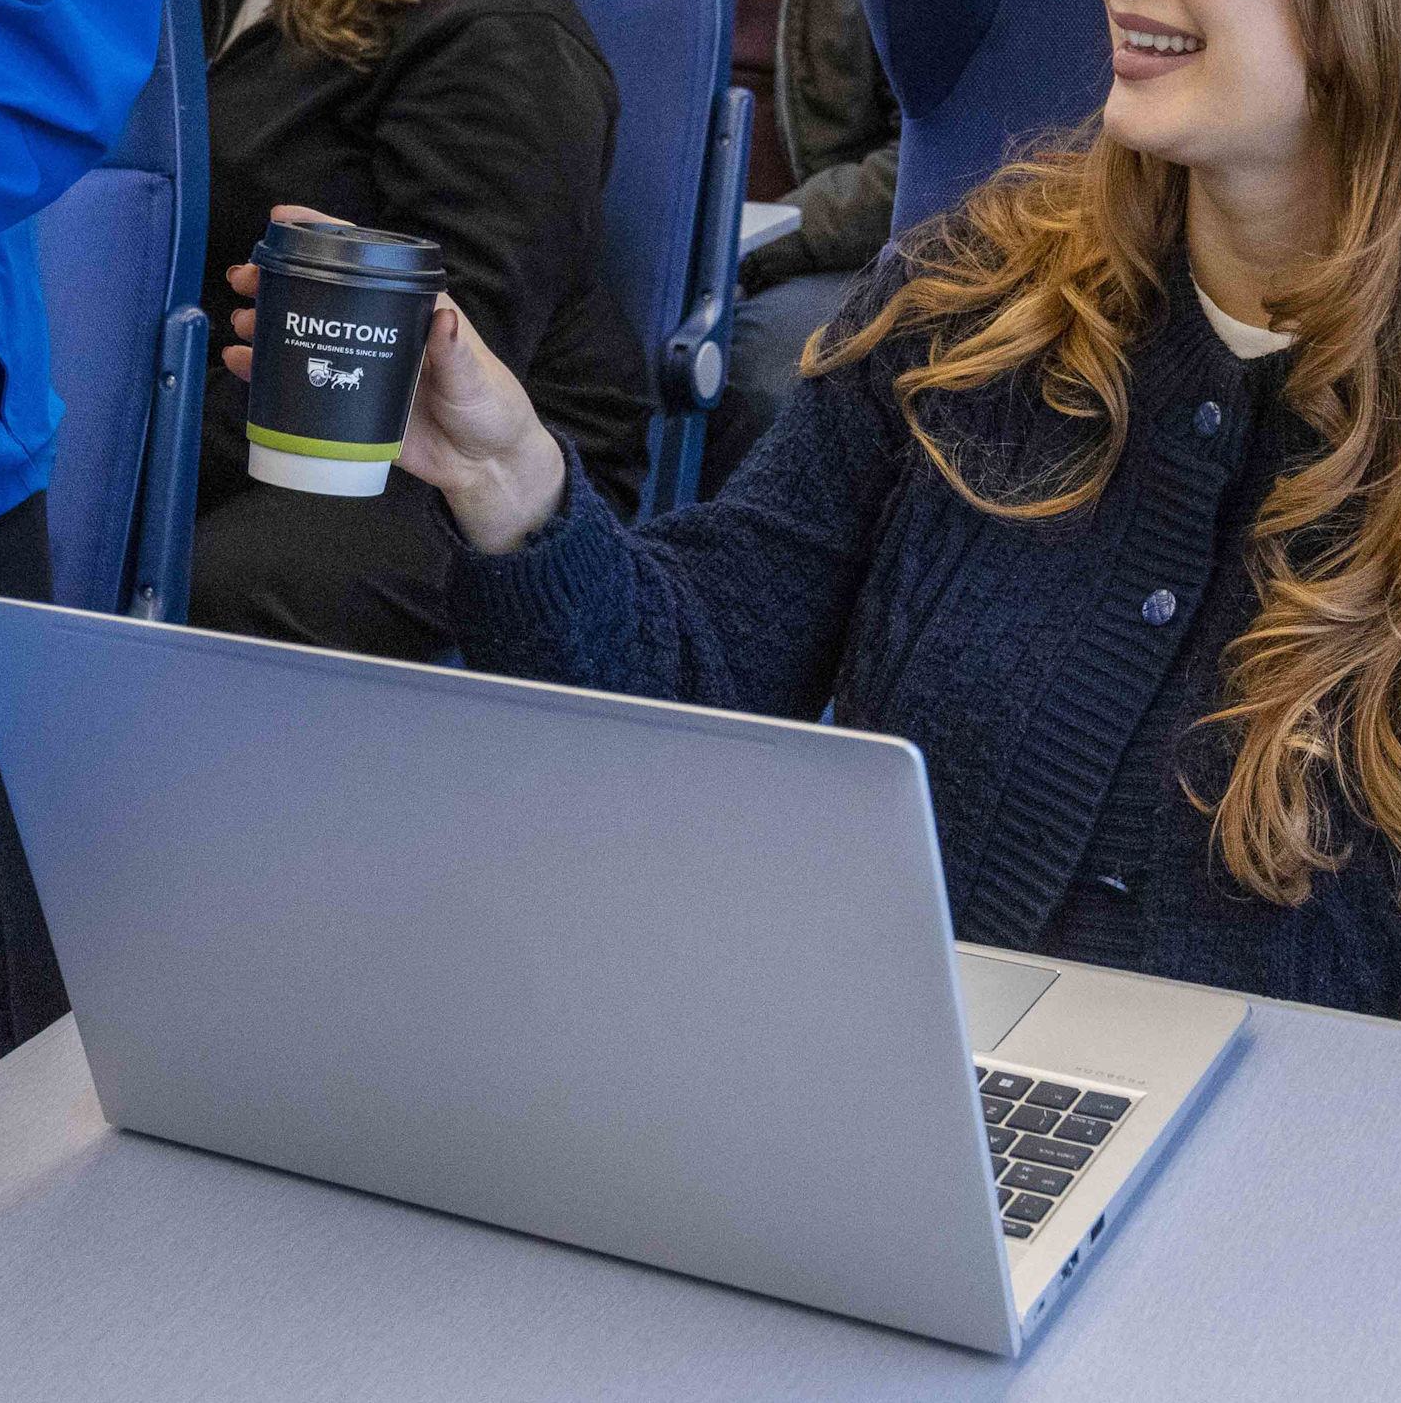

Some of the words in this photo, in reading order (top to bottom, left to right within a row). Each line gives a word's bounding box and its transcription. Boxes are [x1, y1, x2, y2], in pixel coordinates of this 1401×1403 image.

[286, 311, 398, 344] RINGTONS
[291, 339, 316, 350] FAMILY
[317, 343, 354, 355] BUSINESS
[355, 349, 377, 358] SINCE
[379, 351, 394, 359] 1907
